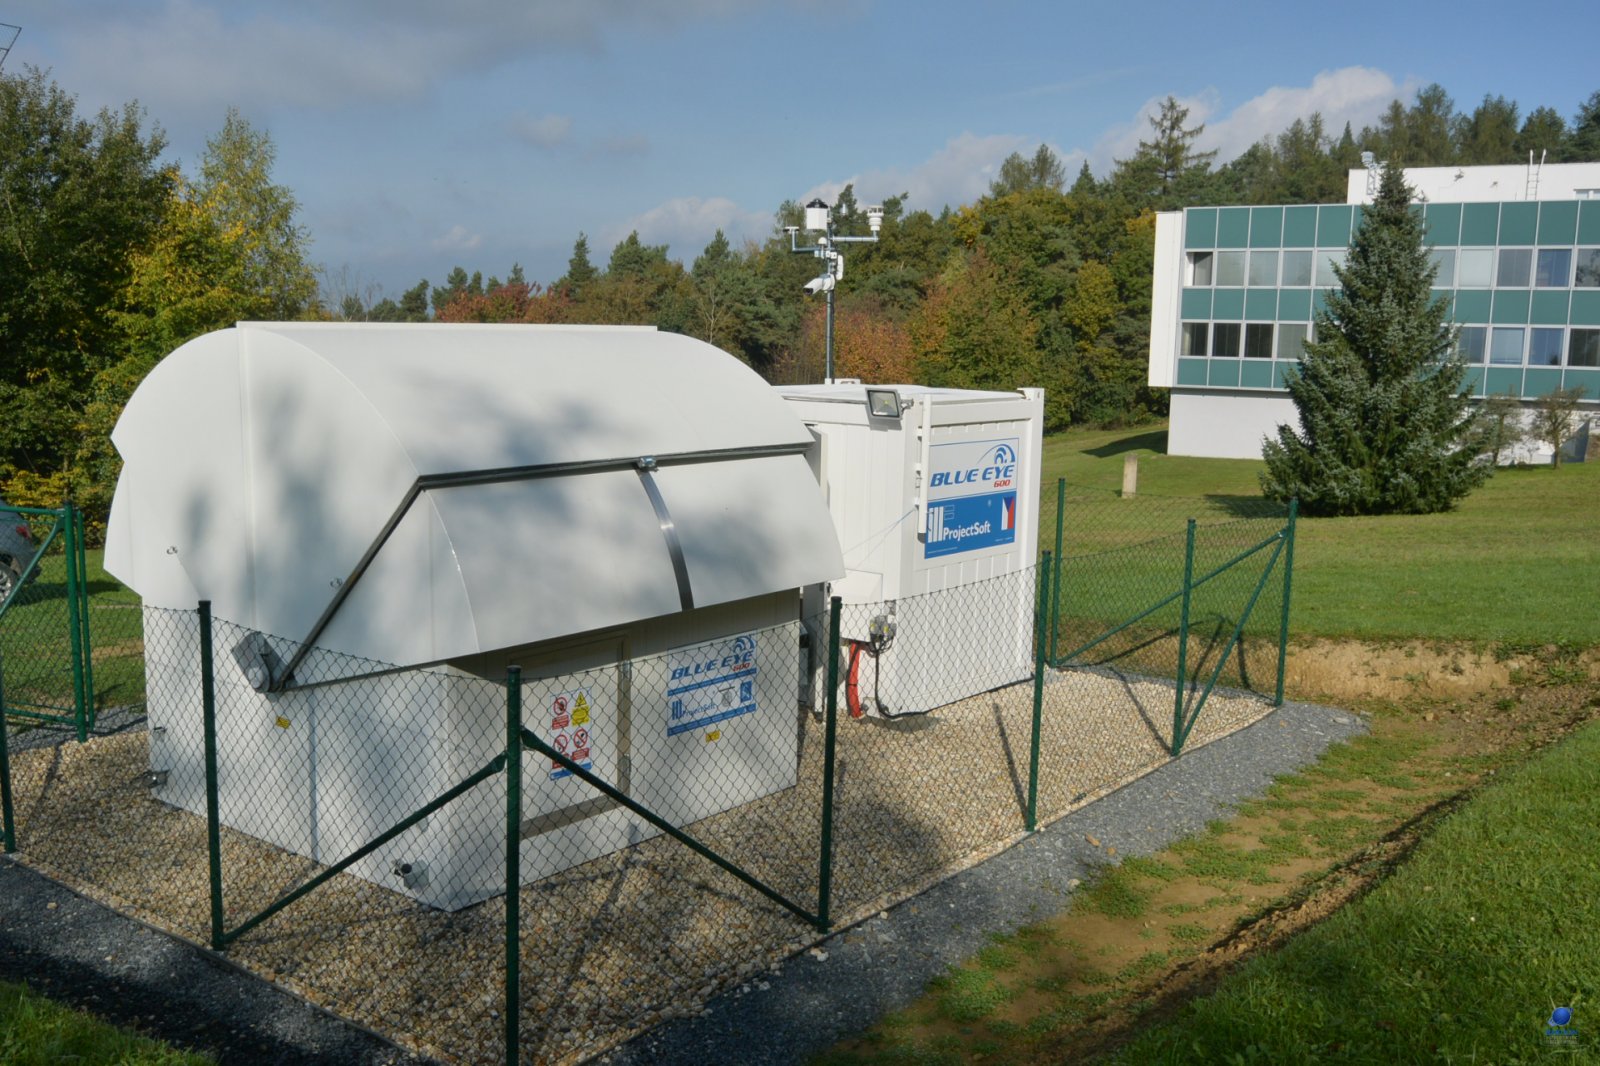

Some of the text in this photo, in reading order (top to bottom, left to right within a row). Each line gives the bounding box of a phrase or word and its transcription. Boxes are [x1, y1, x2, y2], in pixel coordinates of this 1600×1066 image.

[930, 464, 1015, 487] BLUE EYE
[993, 479, 1011, 488] 600
[943, 521, 991, 542] ProjectSoft
[671, 650, 754, 681] BLUE EYE
